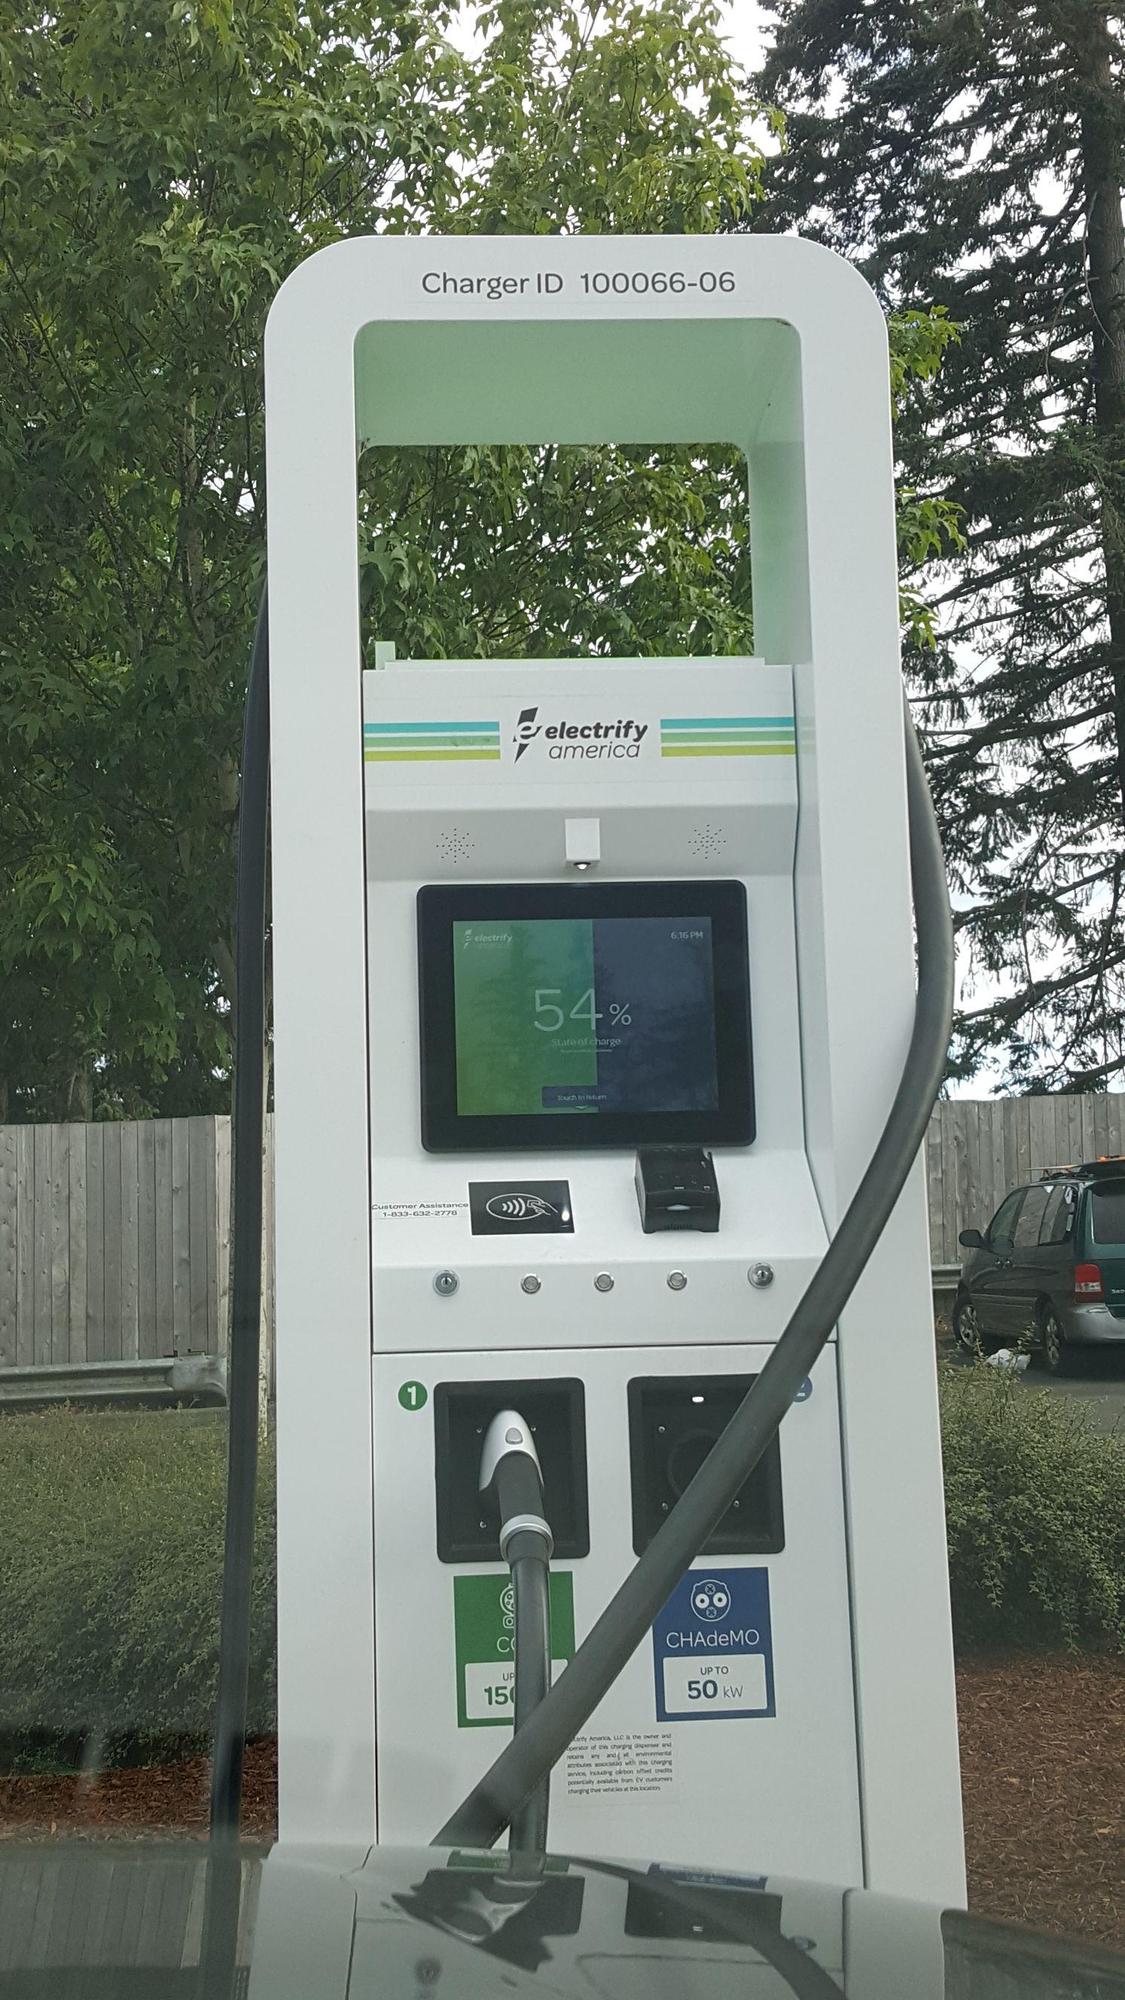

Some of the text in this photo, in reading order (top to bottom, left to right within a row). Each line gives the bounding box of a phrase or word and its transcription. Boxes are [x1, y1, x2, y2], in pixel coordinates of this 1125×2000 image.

[421, 271, 736, 300] Charger ID 100066-06
[545, 719, 648, 743] electrify
[549, 741, 641, 760] america
[690, 931, 704, 939] PM
[383, 1210, 458, 1218] 1-833-632-2778
[419, 1201, 469, 1209] Assistance
[407, 1385, 417, 1406] 1
[665, 1628, 760, 1650] CHAdeMO
[502, 1671, 516, 1681] UP
[700, 1666, 729, 1677] UP TO
[687, 1679, 744, 1700] 50 kW
